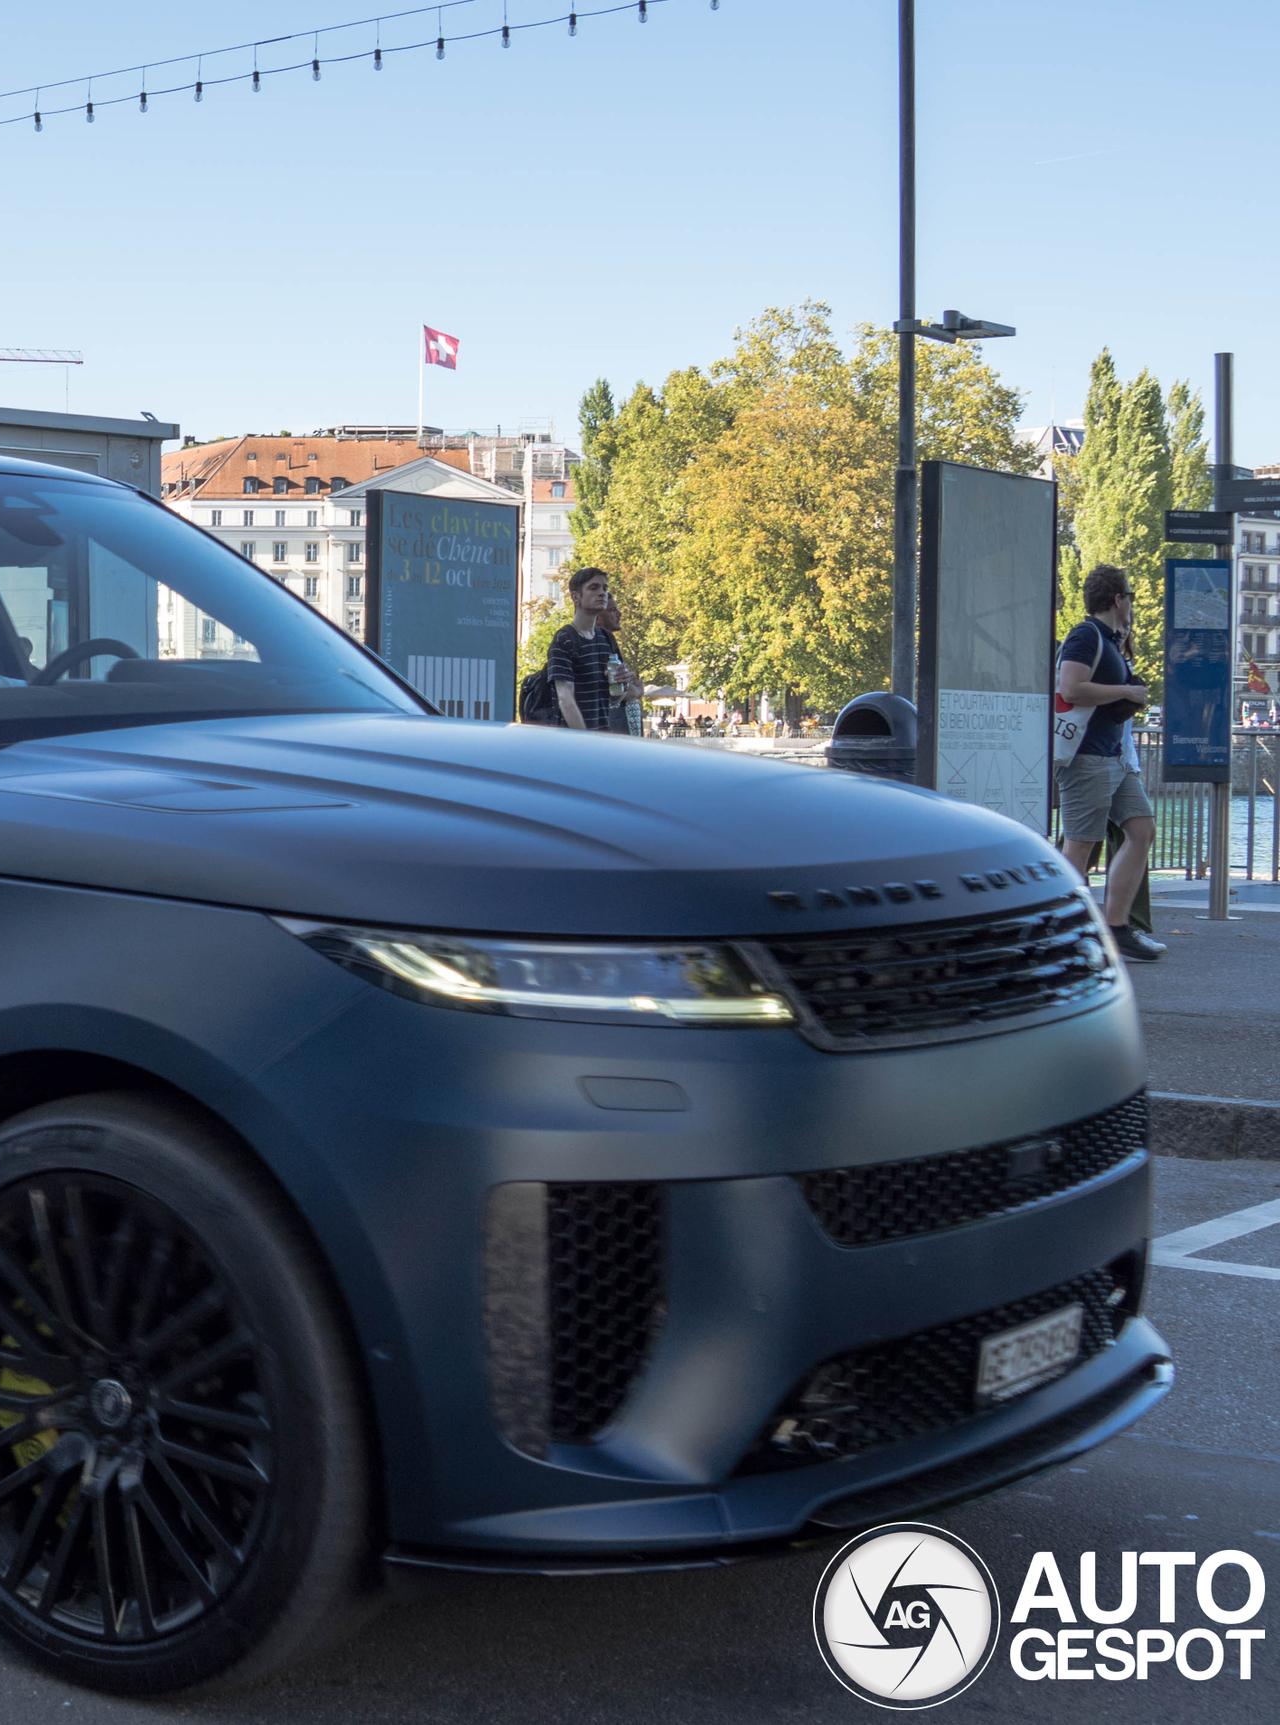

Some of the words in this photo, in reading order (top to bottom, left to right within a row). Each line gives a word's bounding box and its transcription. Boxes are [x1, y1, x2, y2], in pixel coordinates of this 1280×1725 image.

[388, 503, 424, 531] Les
[431, 506, 512, 540] claviers
[387, 536, 407, 557] se
[412, 532, 512, 567] déChênent
[400, 558, 411, 582] 3
[425, 560, 441, 584] 12
[940, 692, 952, 709] ET
[953, 693, 1001, 711] POURTANT
[1001, 695, 1024, 712] TOUT
[1025, 697, 1048, 713] AVAIT
[939, 712, 948, 729] SI
[950, 712, 970, 730] BIEN
[1173, 734, 1209, 744] Bienvenue
[1195, 745, 1228, 754] Welcome
